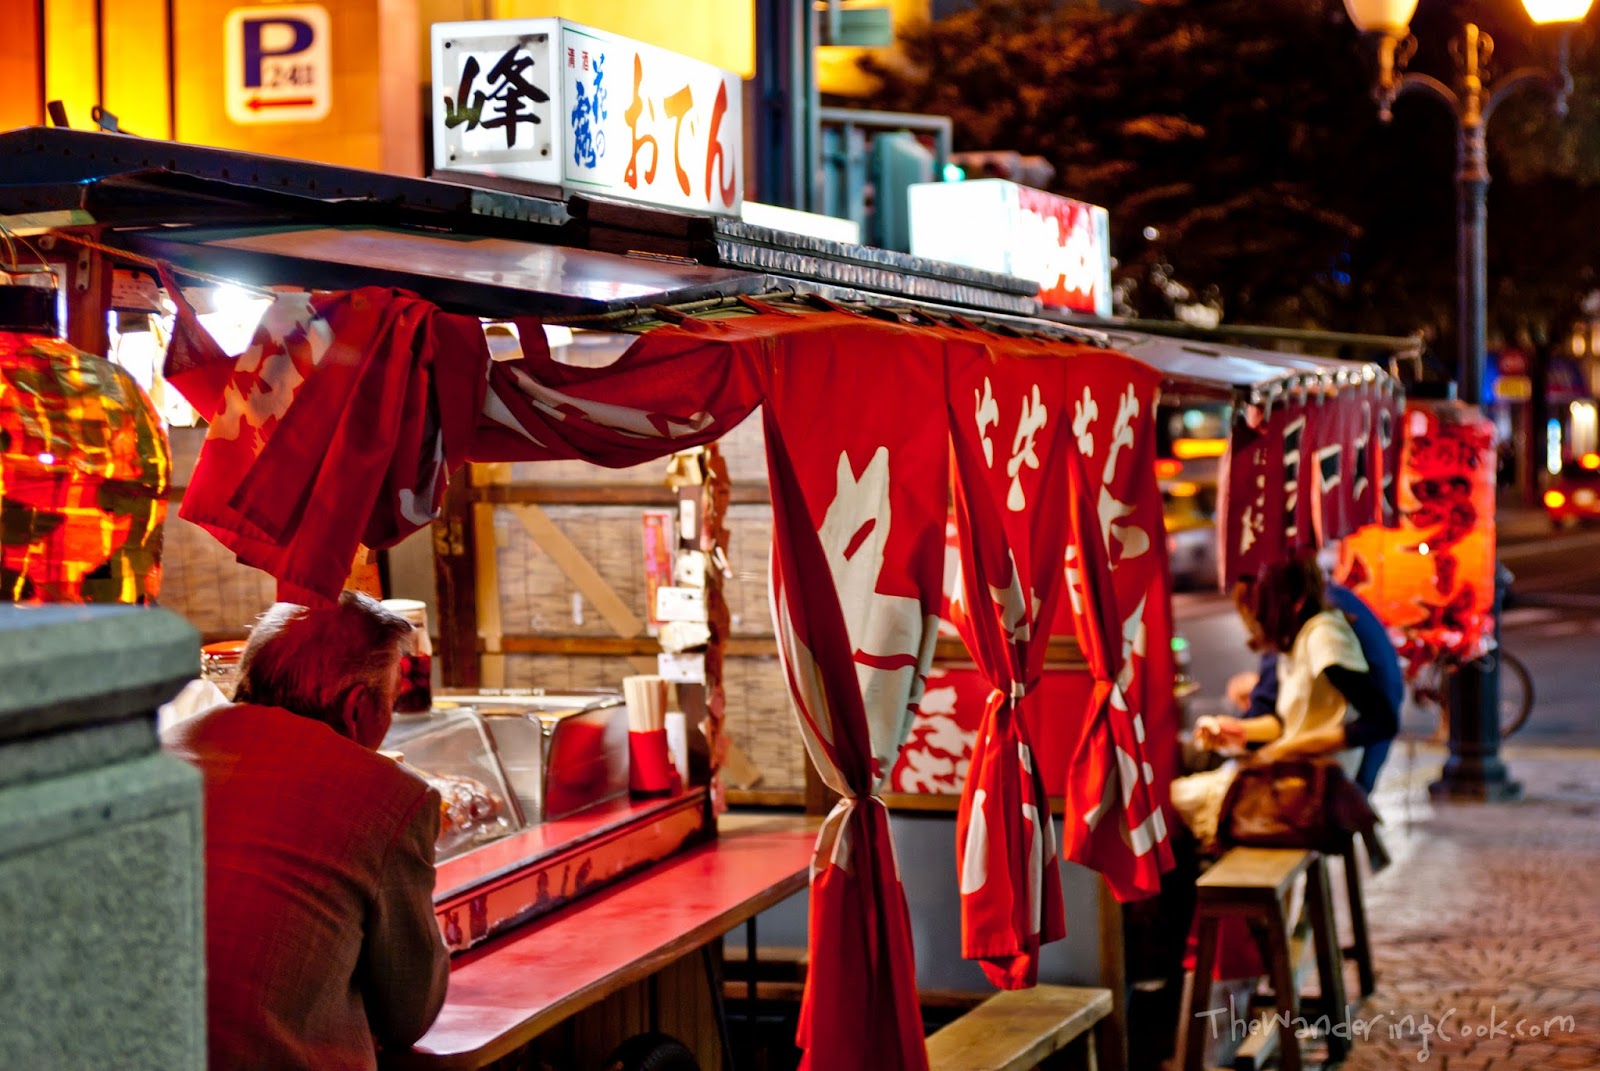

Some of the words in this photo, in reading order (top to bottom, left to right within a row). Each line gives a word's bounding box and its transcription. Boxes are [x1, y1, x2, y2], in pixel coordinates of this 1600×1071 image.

[243, 18, 315, 88] P
[443, 44, 551, 149] 峰
[624, 51, 736, 209] おでん
